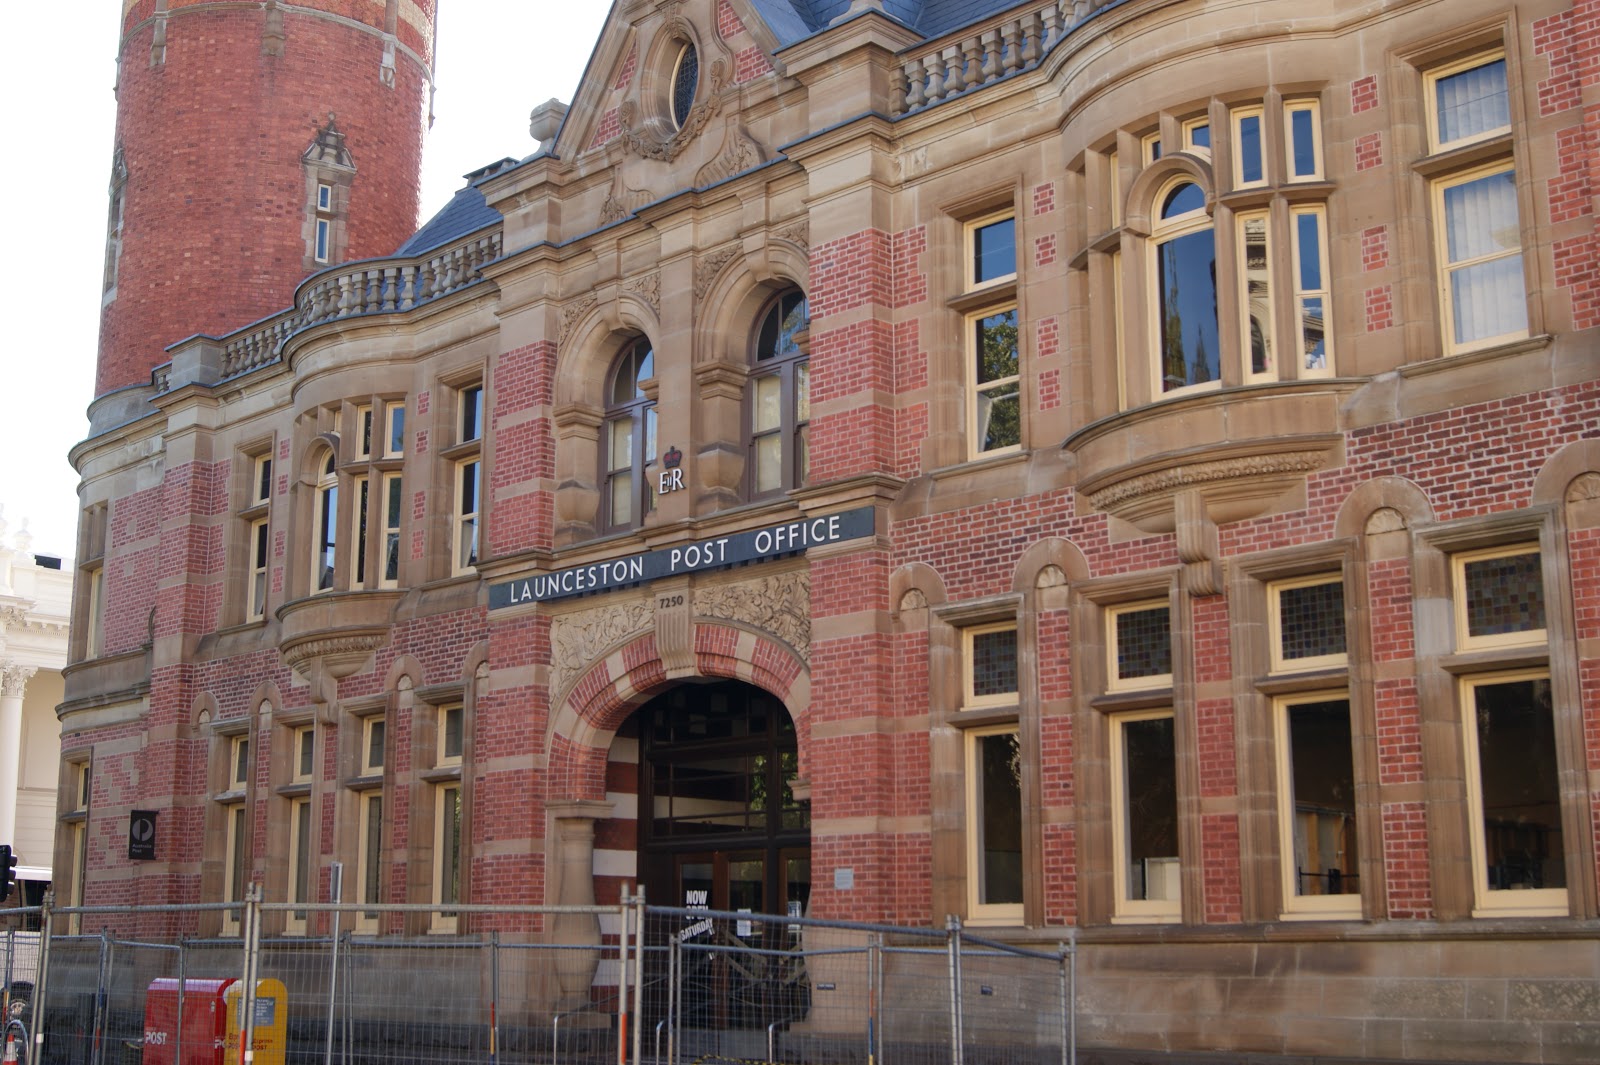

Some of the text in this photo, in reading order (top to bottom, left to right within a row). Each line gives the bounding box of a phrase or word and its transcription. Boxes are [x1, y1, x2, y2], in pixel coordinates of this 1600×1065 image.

[510, 515, 841, 603] LAUNCESTON POST OFFICE
[660, 595, 684, 609] 7250
[686, 890, 708, 905] NOW
[680, 917, 713, 941] SATURDAY
[145, 1031, 168, 1045] POST
